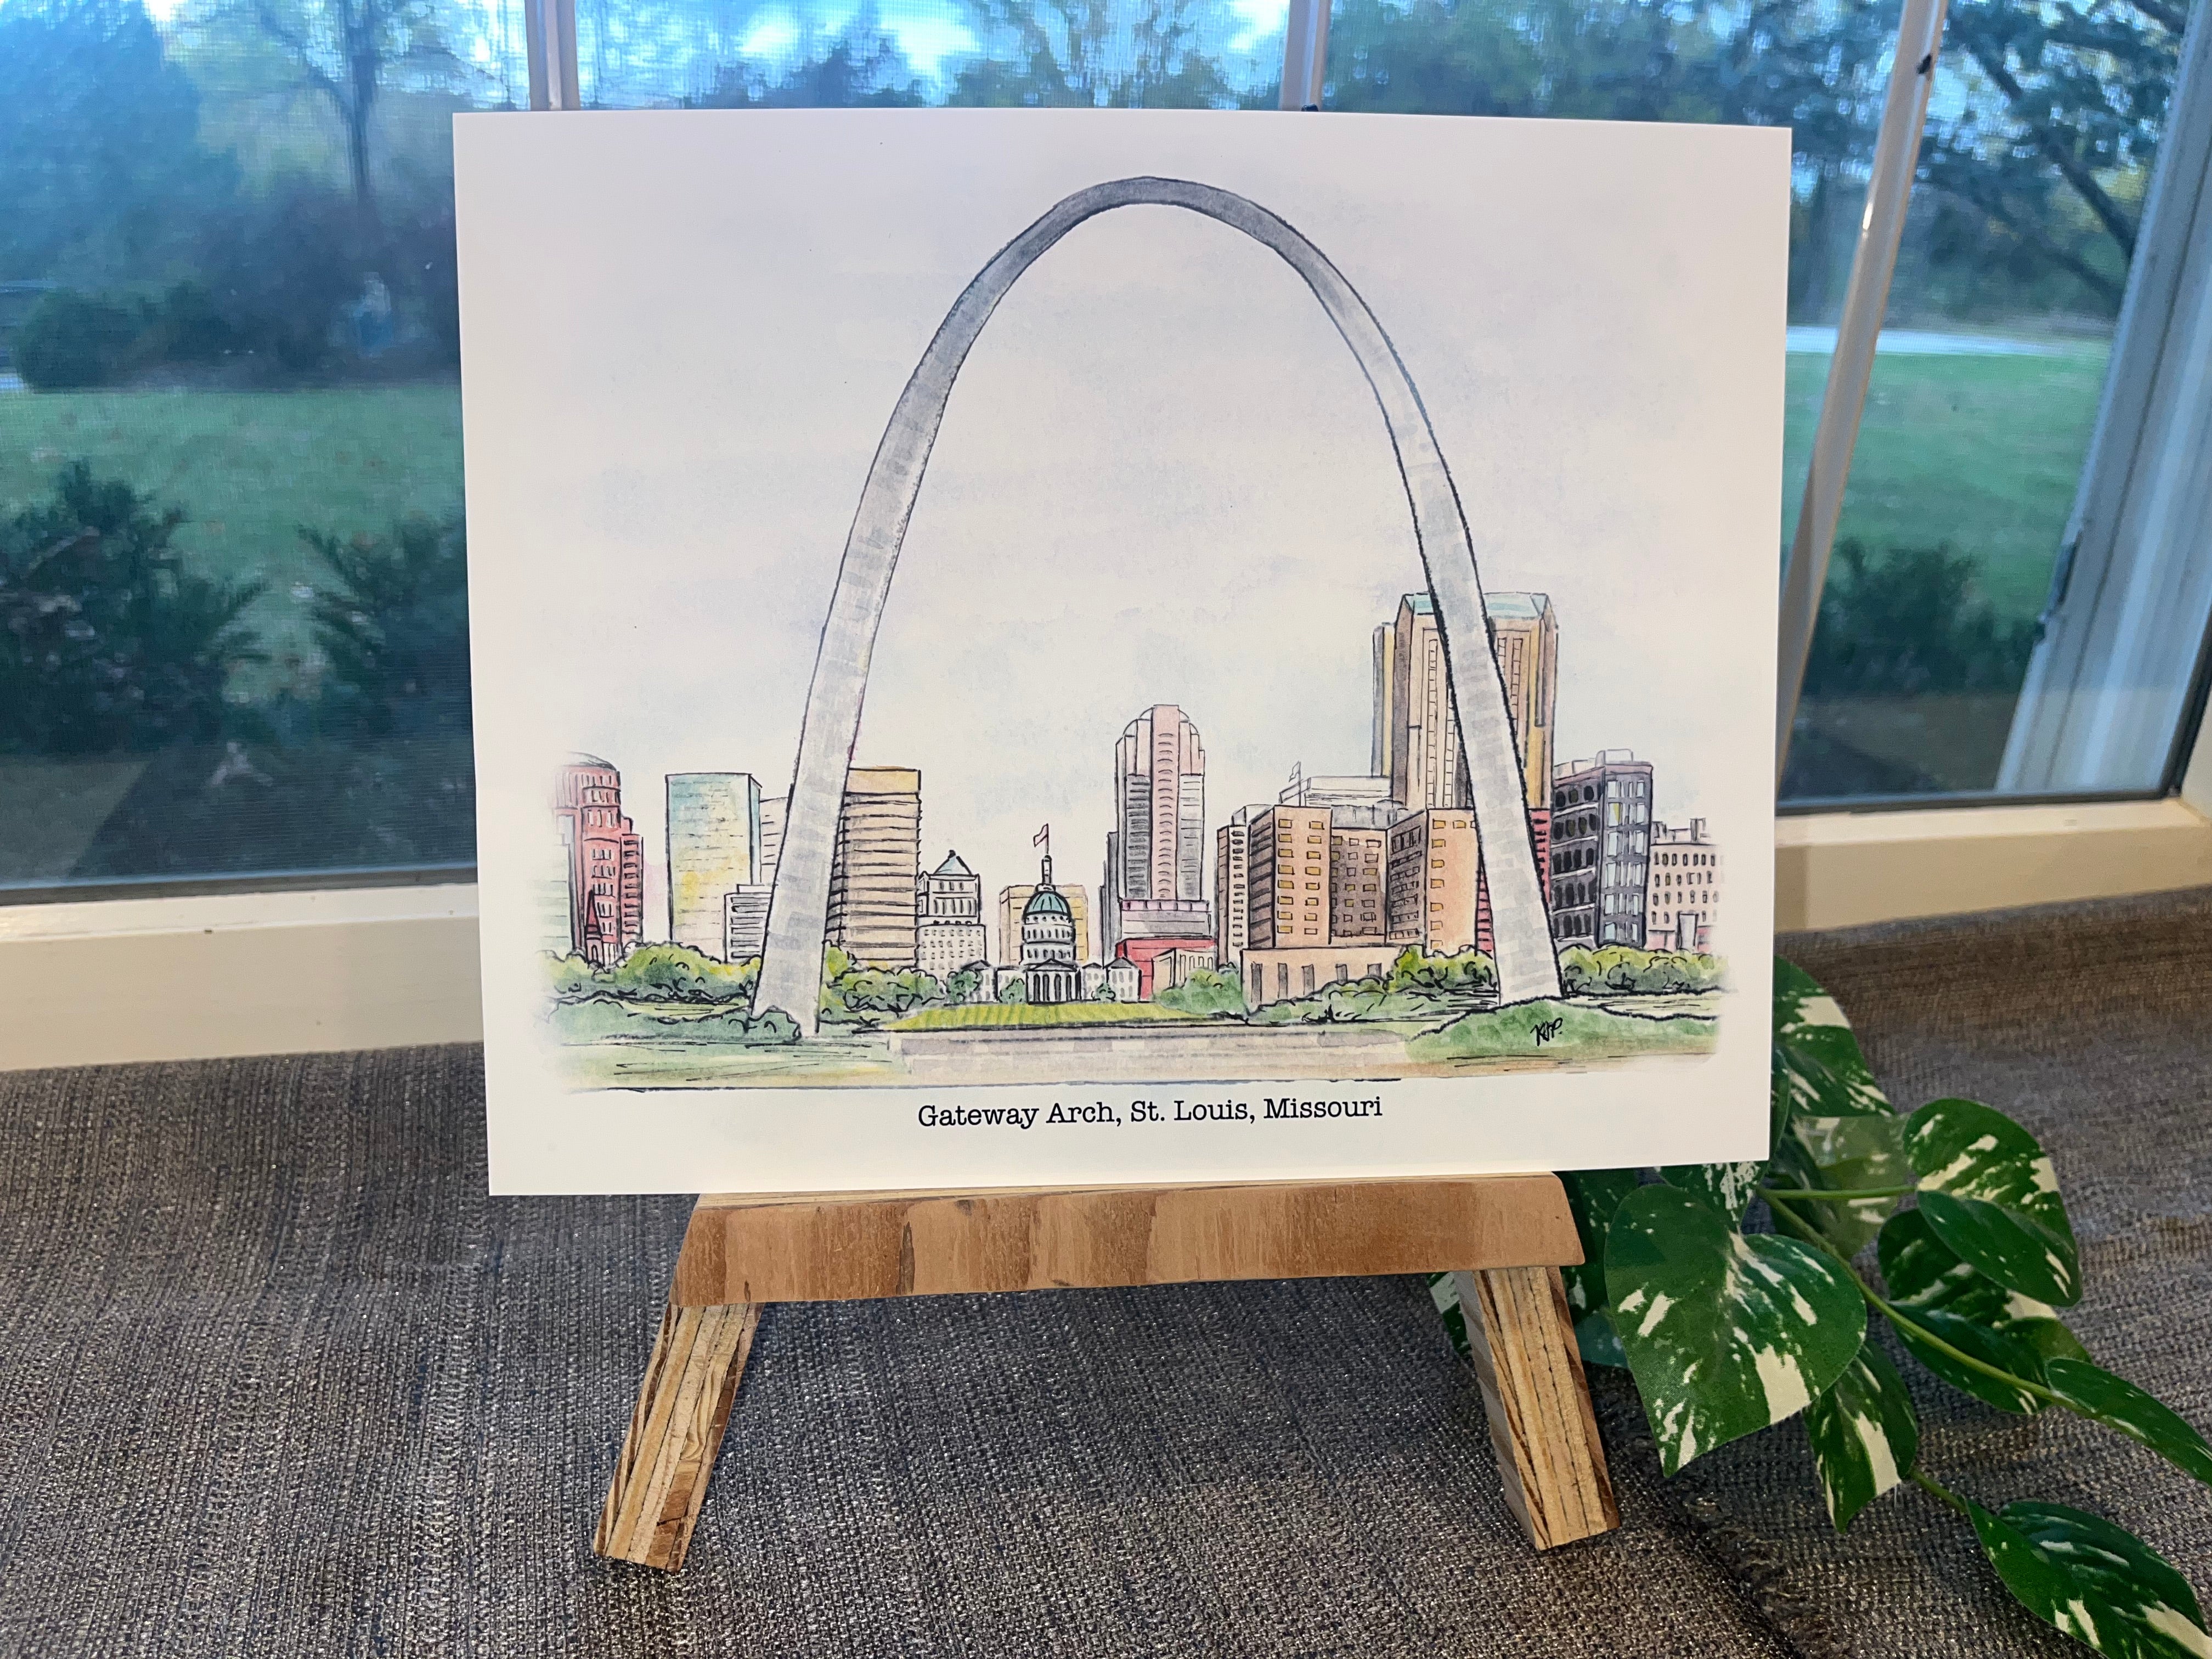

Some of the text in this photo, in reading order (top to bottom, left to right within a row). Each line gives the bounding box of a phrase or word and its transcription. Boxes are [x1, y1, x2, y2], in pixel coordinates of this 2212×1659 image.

[918, 1096, 1383, 1130] Gateway Arch, St. Louis, Missouri
